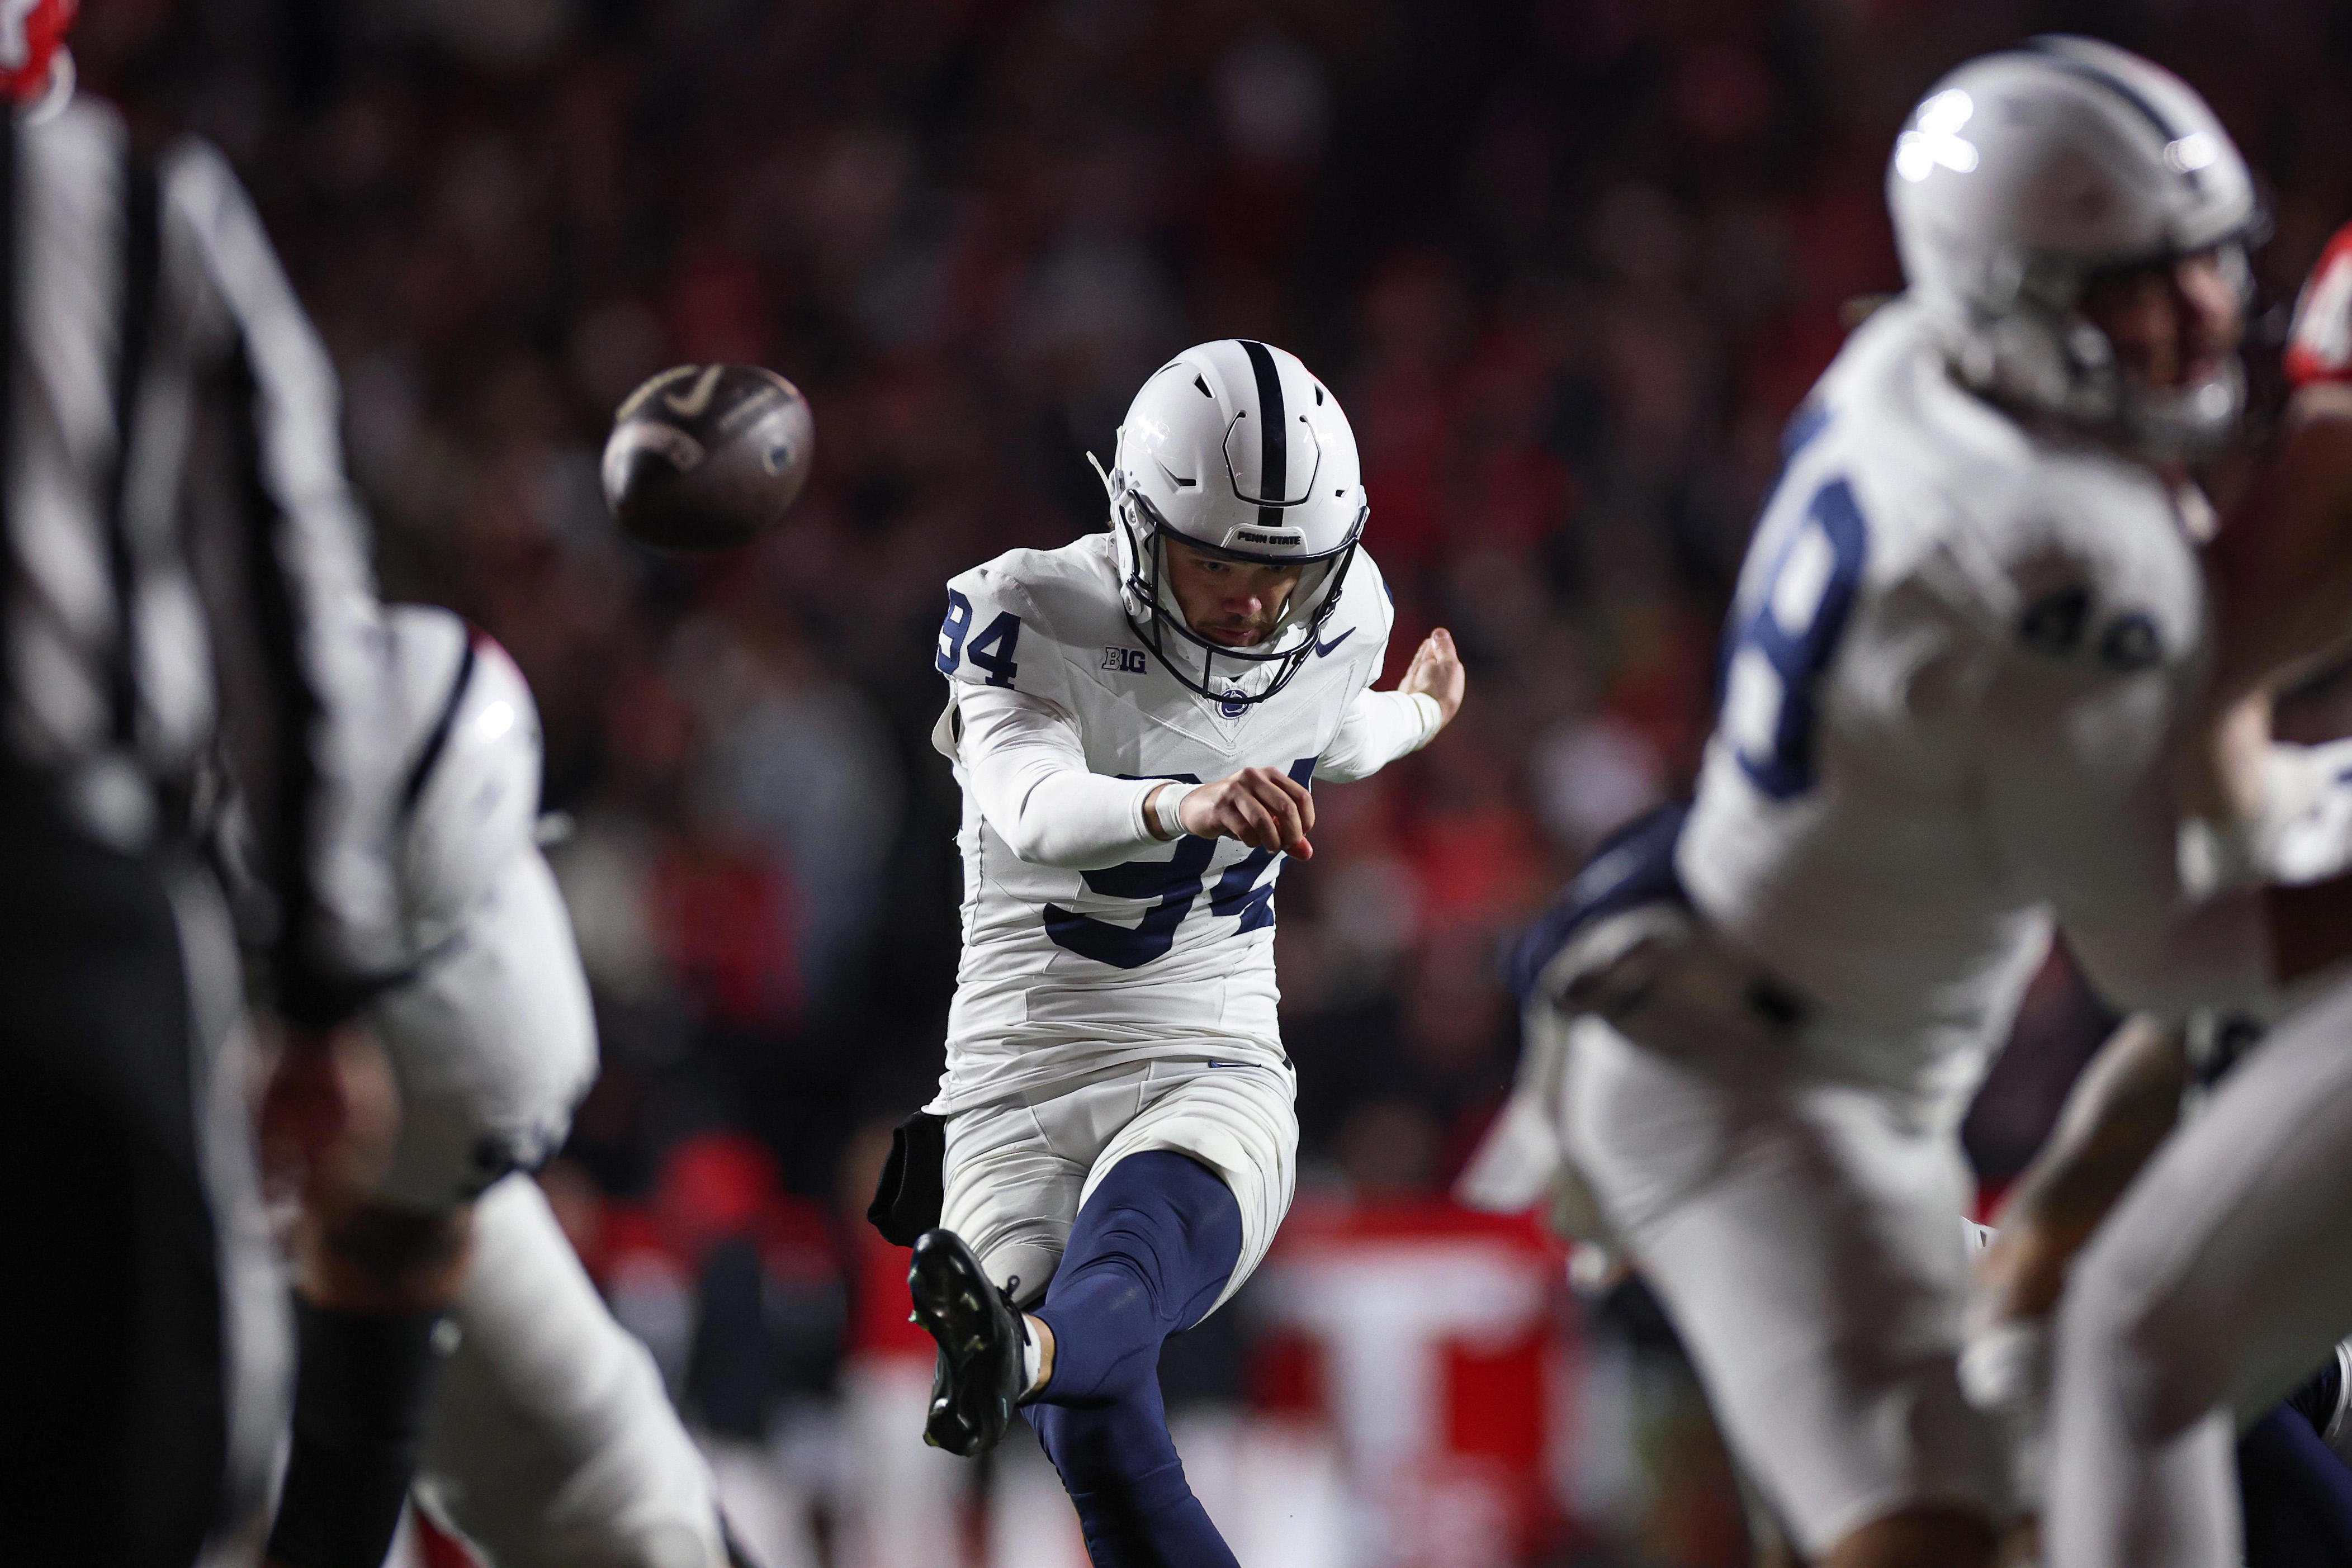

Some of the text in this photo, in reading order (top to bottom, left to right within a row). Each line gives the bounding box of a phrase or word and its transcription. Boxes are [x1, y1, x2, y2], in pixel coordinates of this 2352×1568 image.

[1237, 531, 1302, 545] PENN STATE
[936, 588, 1021, 690] 94
[1043, 751, 1321, 969] 94
